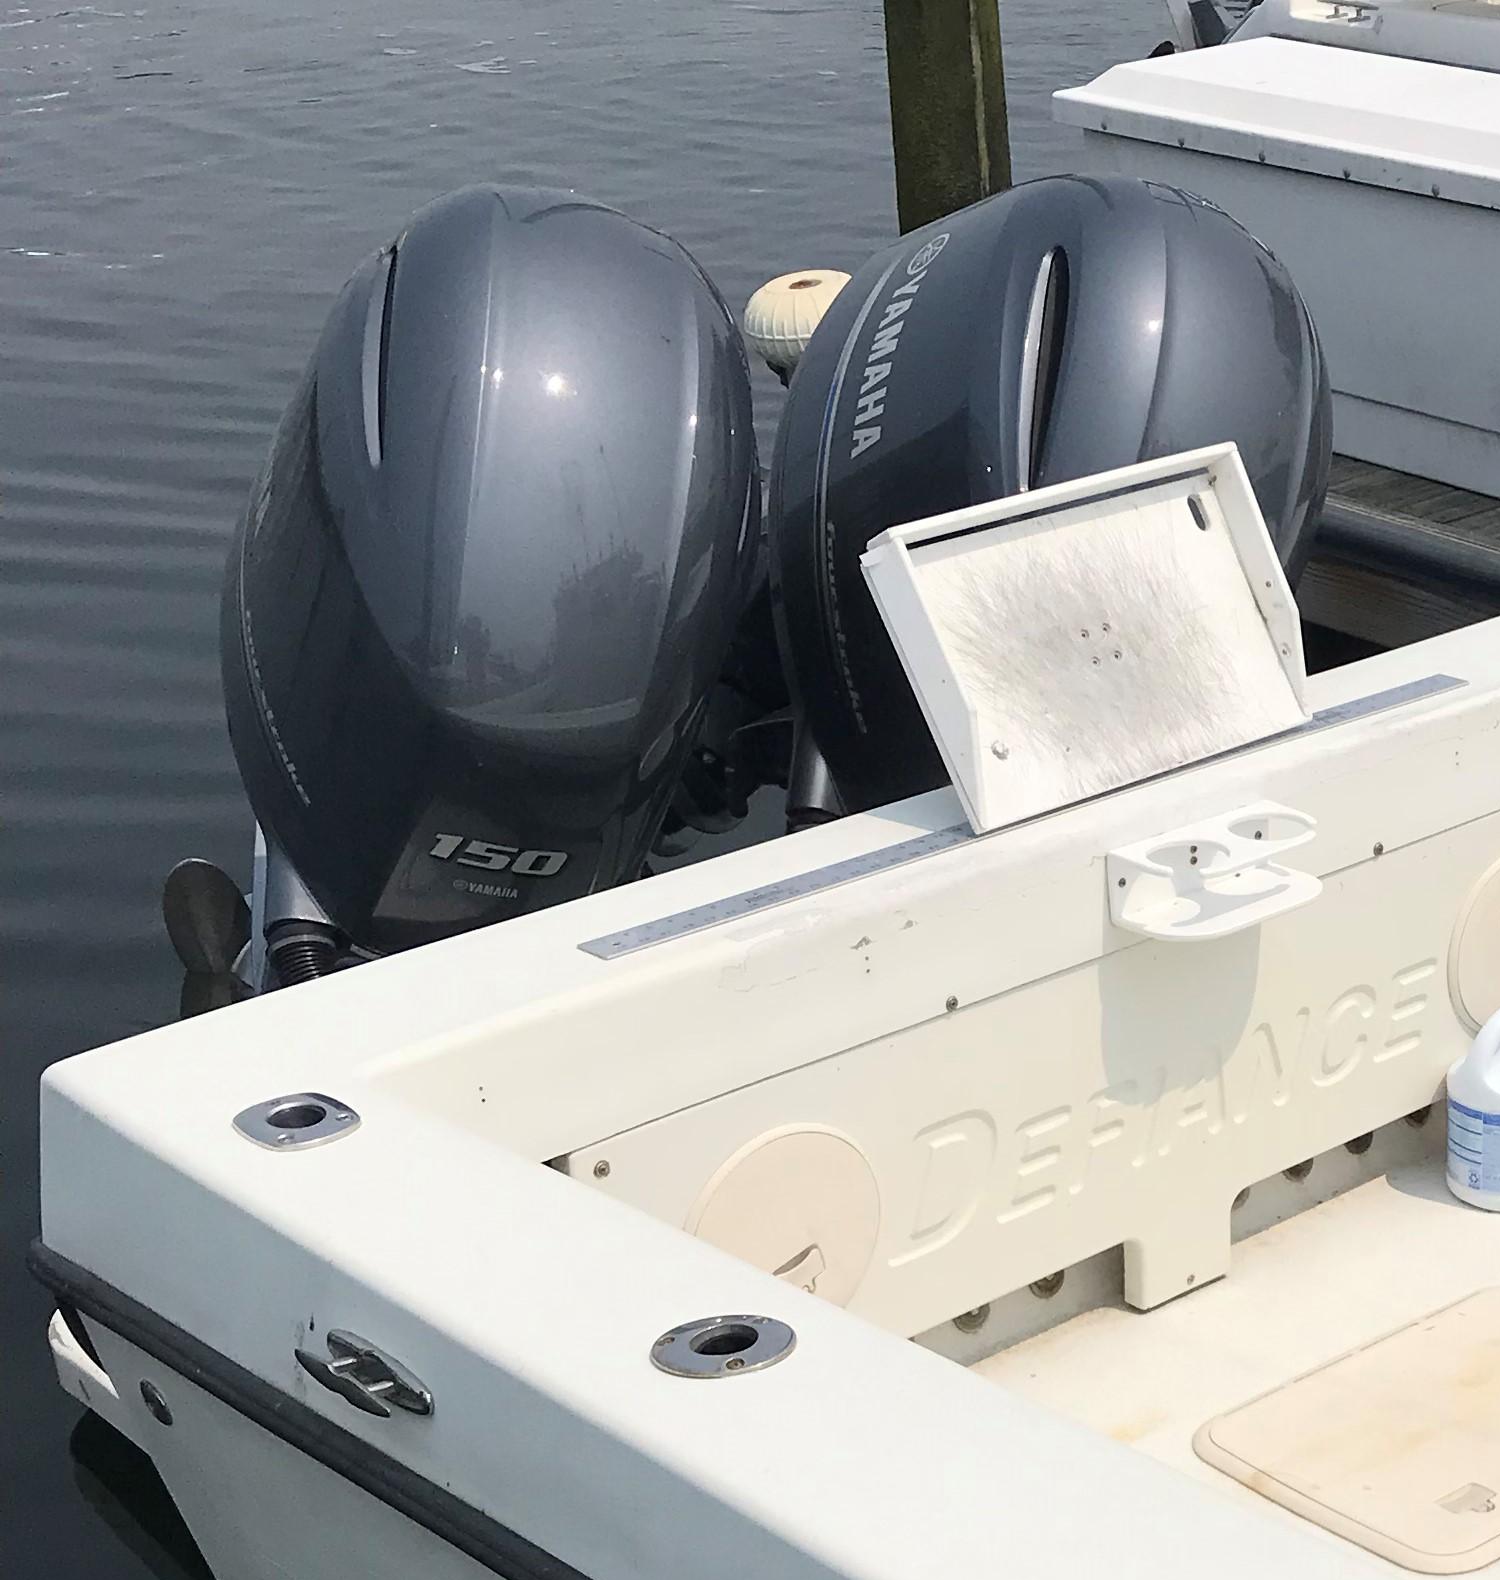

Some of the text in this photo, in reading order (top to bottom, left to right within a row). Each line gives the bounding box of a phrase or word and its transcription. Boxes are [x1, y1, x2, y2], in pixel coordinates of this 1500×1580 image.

[850, 269, 928, 460] YAMAHA
[428, 832, 569, 877] 150
[467, 881, 519, 899] YAMAHA
[887, 957, 1438, 1269] DEFIANCE
